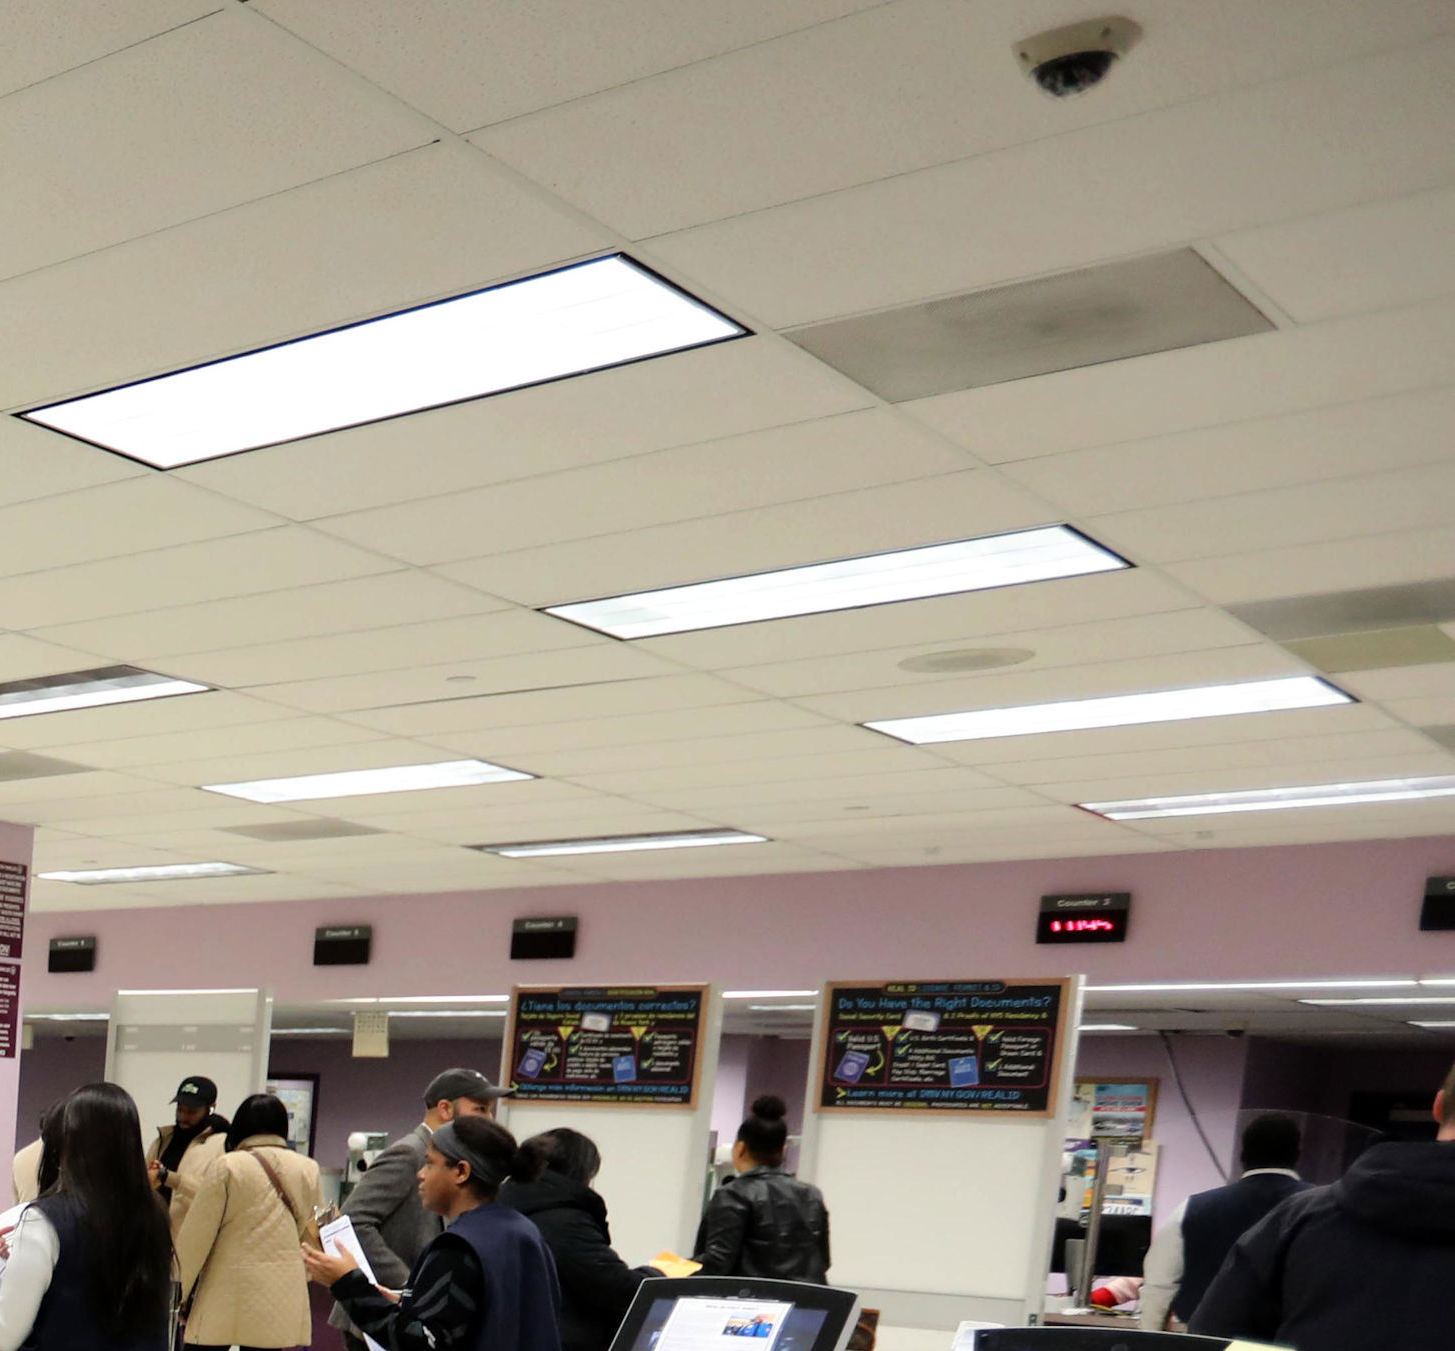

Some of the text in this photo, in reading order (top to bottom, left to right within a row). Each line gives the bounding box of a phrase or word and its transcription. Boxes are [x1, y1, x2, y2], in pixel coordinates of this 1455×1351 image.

[1057, 899, 1098, 907] Counter
[839, 996, 1051, 1010] Do You Have the Right Documents?
